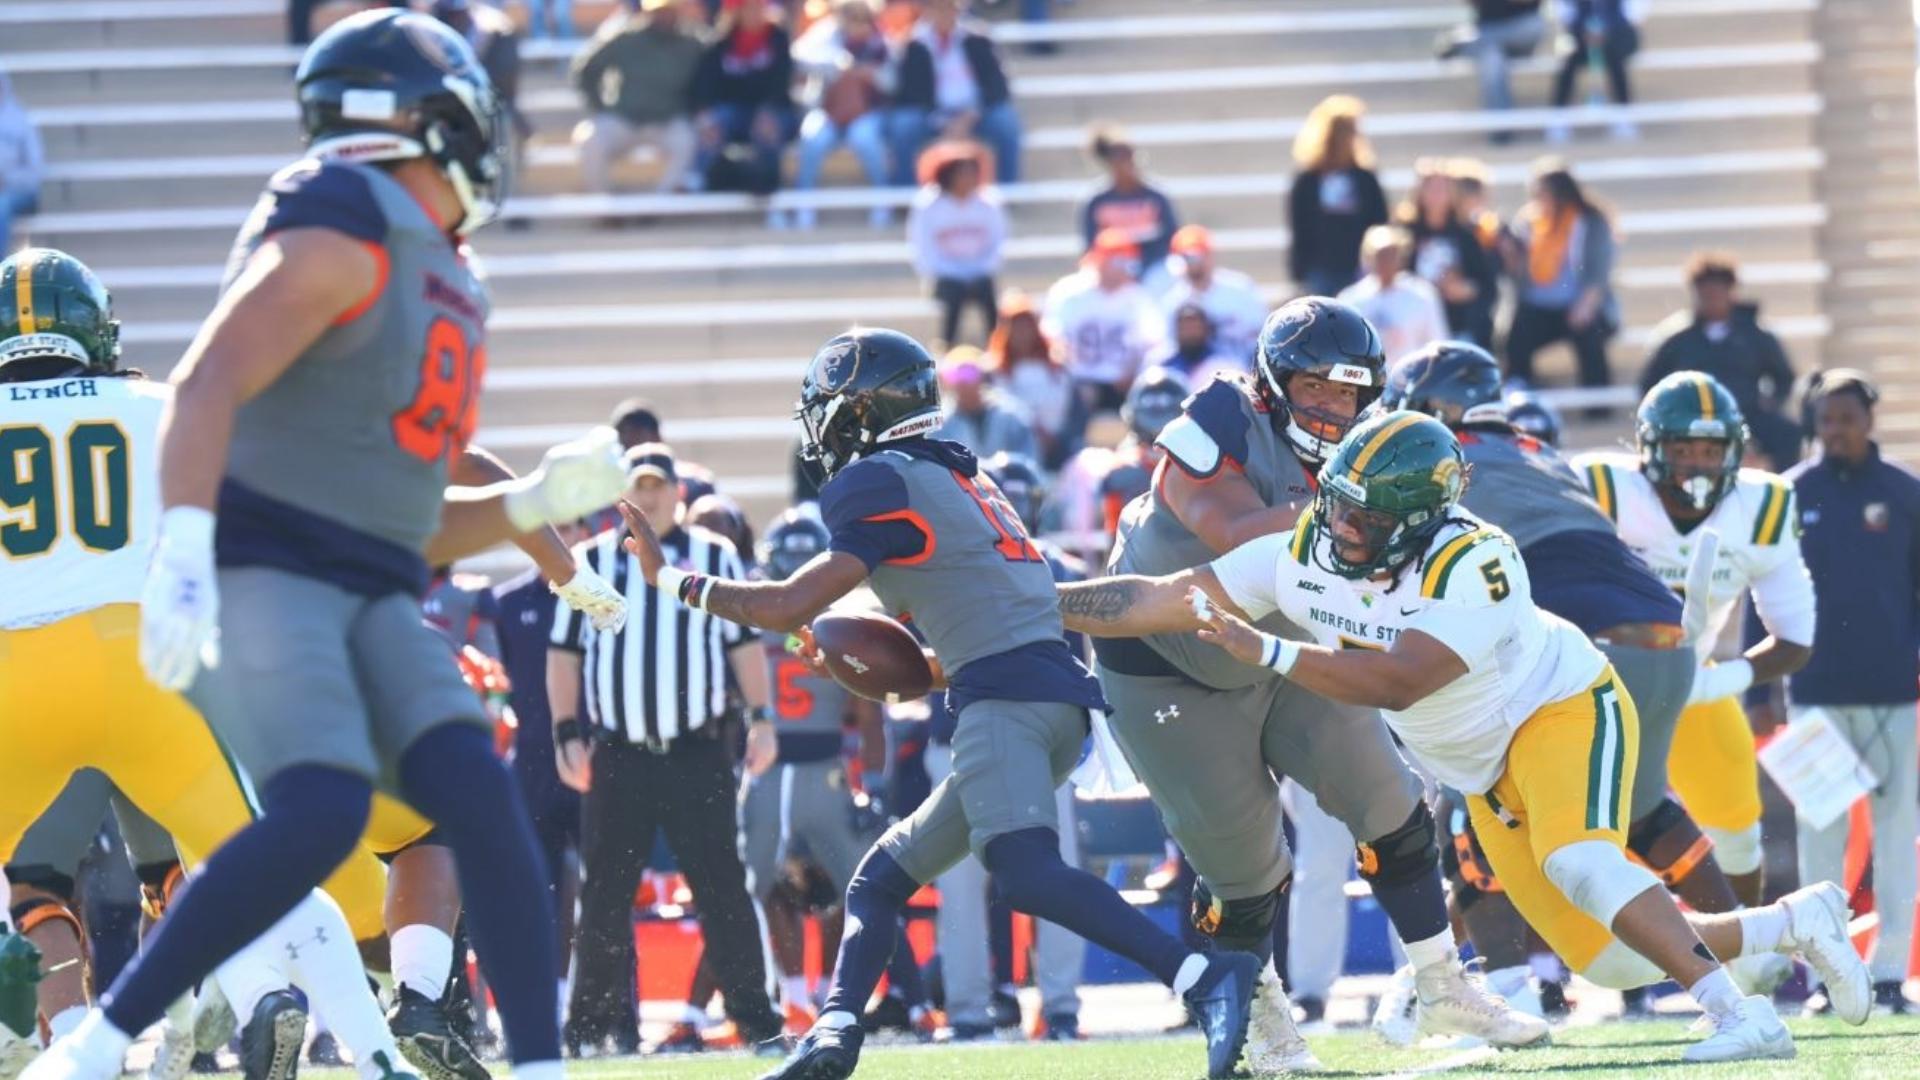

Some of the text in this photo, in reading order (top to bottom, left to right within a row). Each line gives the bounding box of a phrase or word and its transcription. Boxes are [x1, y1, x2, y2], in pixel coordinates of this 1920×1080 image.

[1342, 368, 1365, 380] 1867
[10, 379, 98, 401] LYNCH
[889, 417, 933, 438] NATIONAL
[0, 419, 133, 560] 90
[1297, 579, 1326, 594] MEAC
[1479, 556, 1511, 602] 5
[1310, 607, 1403, 641] NORFOLK STA
[776, 661, 811, 719] 5
